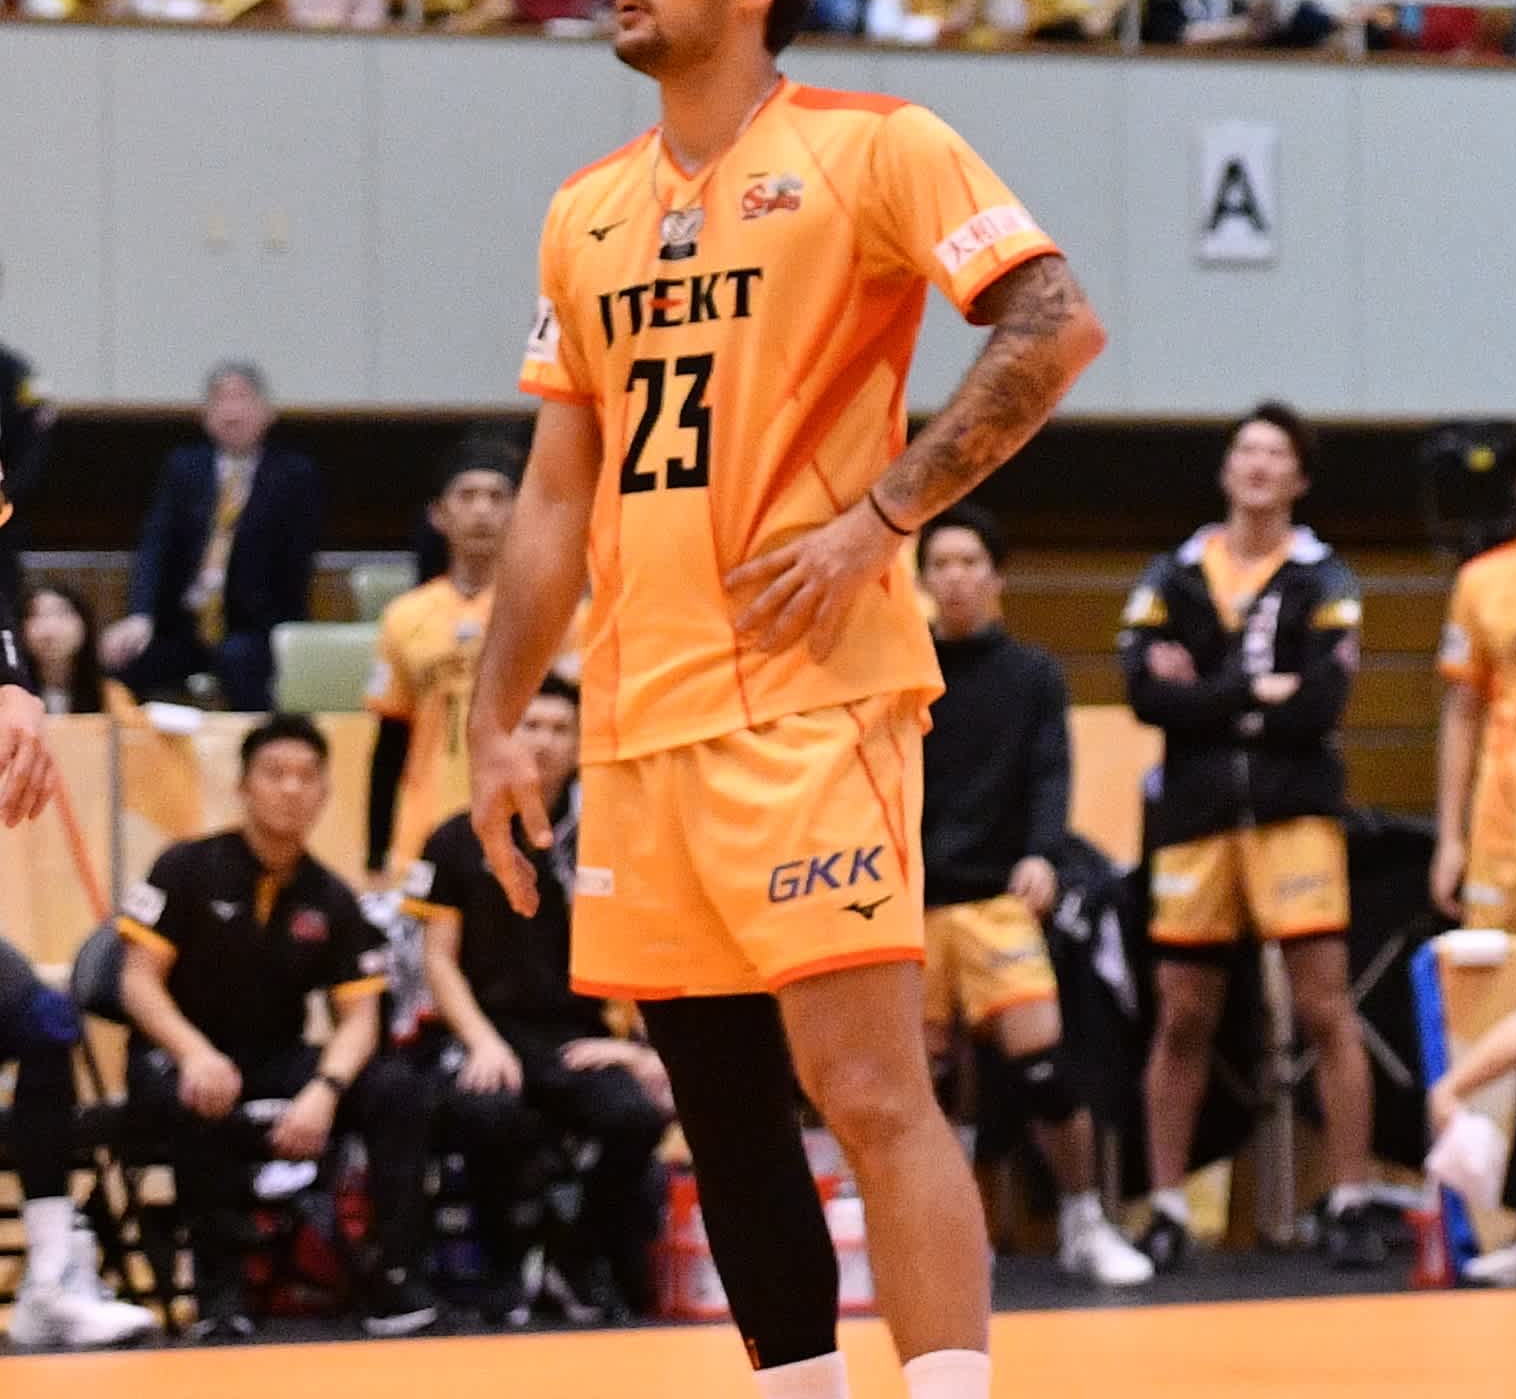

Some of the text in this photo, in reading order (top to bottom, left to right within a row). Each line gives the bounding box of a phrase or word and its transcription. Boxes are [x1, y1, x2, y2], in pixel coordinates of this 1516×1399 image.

[1202, 156, 1270, 233] A
[618, 352, 715, 495] 23
[768, 844, 884, 904] GKK
